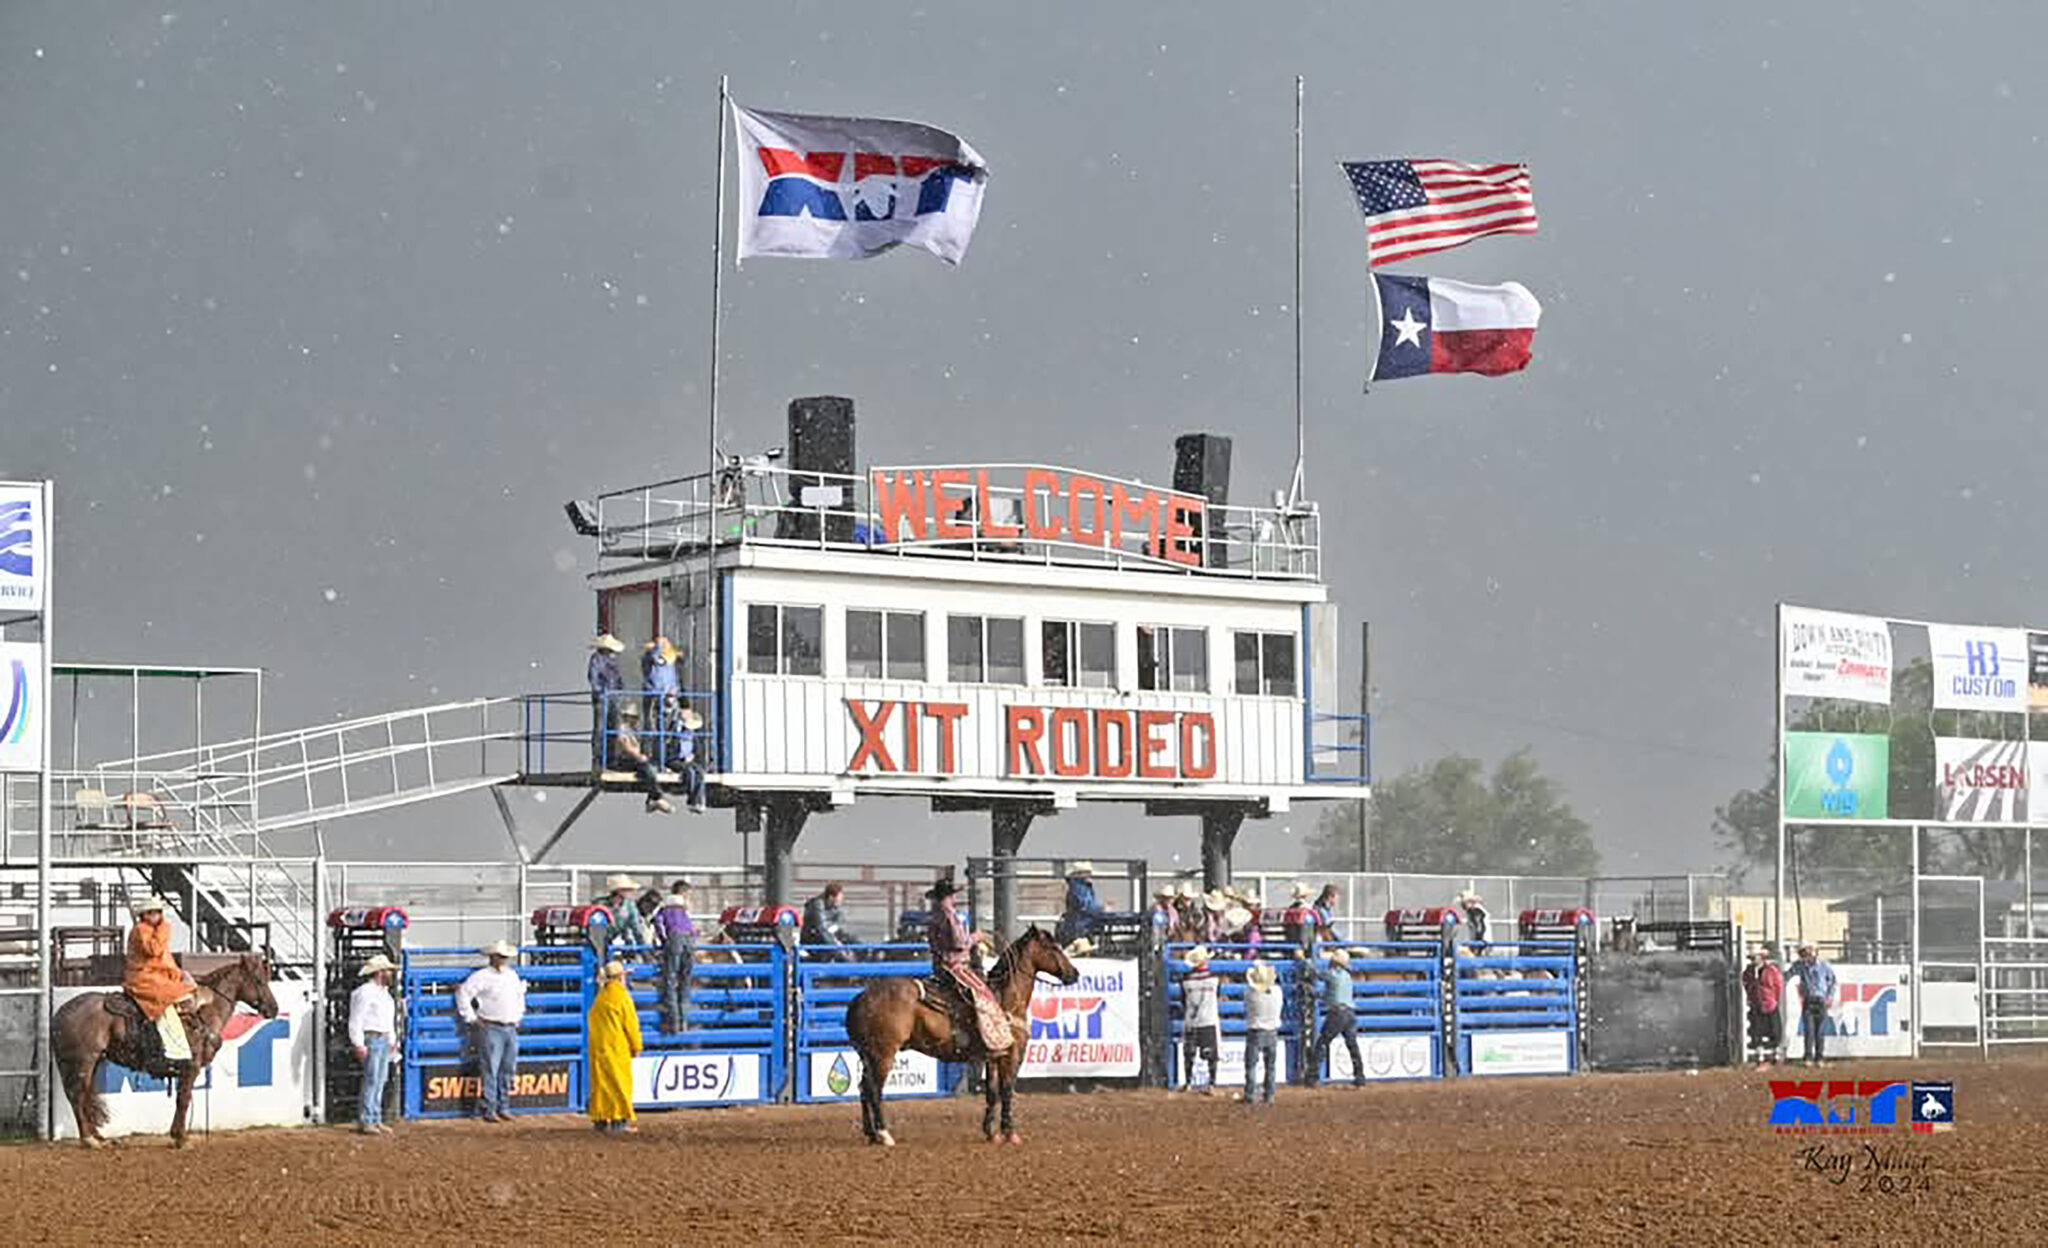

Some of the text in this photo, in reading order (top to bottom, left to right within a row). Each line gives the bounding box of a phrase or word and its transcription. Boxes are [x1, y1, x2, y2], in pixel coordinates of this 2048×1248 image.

[873, 467, 1205, 567] WELCOME
[1952, 674, 2017, 699] CUSTOM
[845, 697, 1218, 782] XIT RODEO
[1943, 761, 2026, 789] LARSEN
[1051, 1043, 1063, 1063] &
[1067, 1042, 1134, 1063] REUNION
[665, 1063, 720, 1091] JBS
